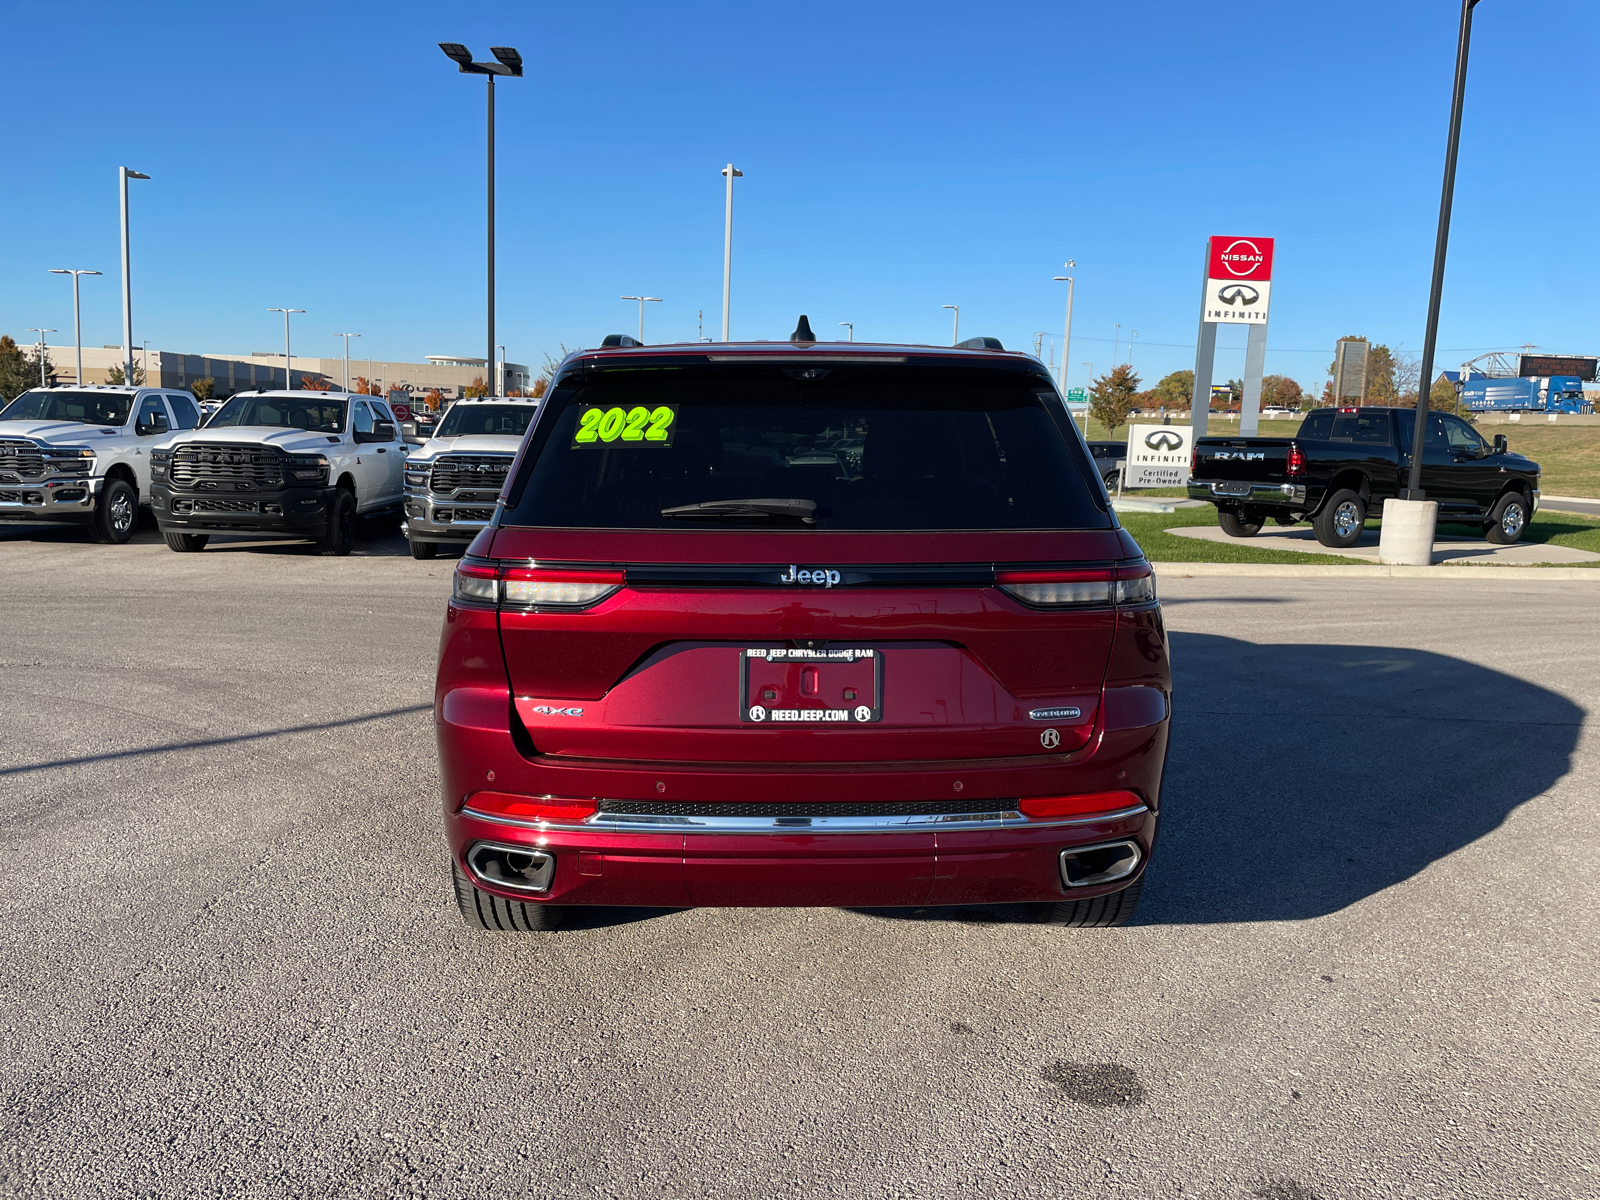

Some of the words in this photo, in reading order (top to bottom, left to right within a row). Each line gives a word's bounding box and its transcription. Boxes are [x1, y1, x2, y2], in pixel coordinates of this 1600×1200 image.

[1221, 254, 1263, 262] NISSAN
[1208, 310, 1266, 320] INFINITI
[575, 406, 675, 443] 2022
[197, 453, 252, 464] RAM
[1137, 455, 1187, 463] INFINITI
[1214, 451, 1265, 461] RAM
[1143, 469, 1179, 477] Certified
[1138, 477, 1182, 485] Pre-Owned
[781, 565, 841, 589] Jeep
[747, 649, 767, 657] REED
[768, 649, 786, 657] JEEP
[788, 649, 827, 658] CHRYSLER
[828, 649, 854, 658] DODGE
[855, 649, 874, 658] RAM
[771, 709, 849, 721] REEDJEEP.COM
